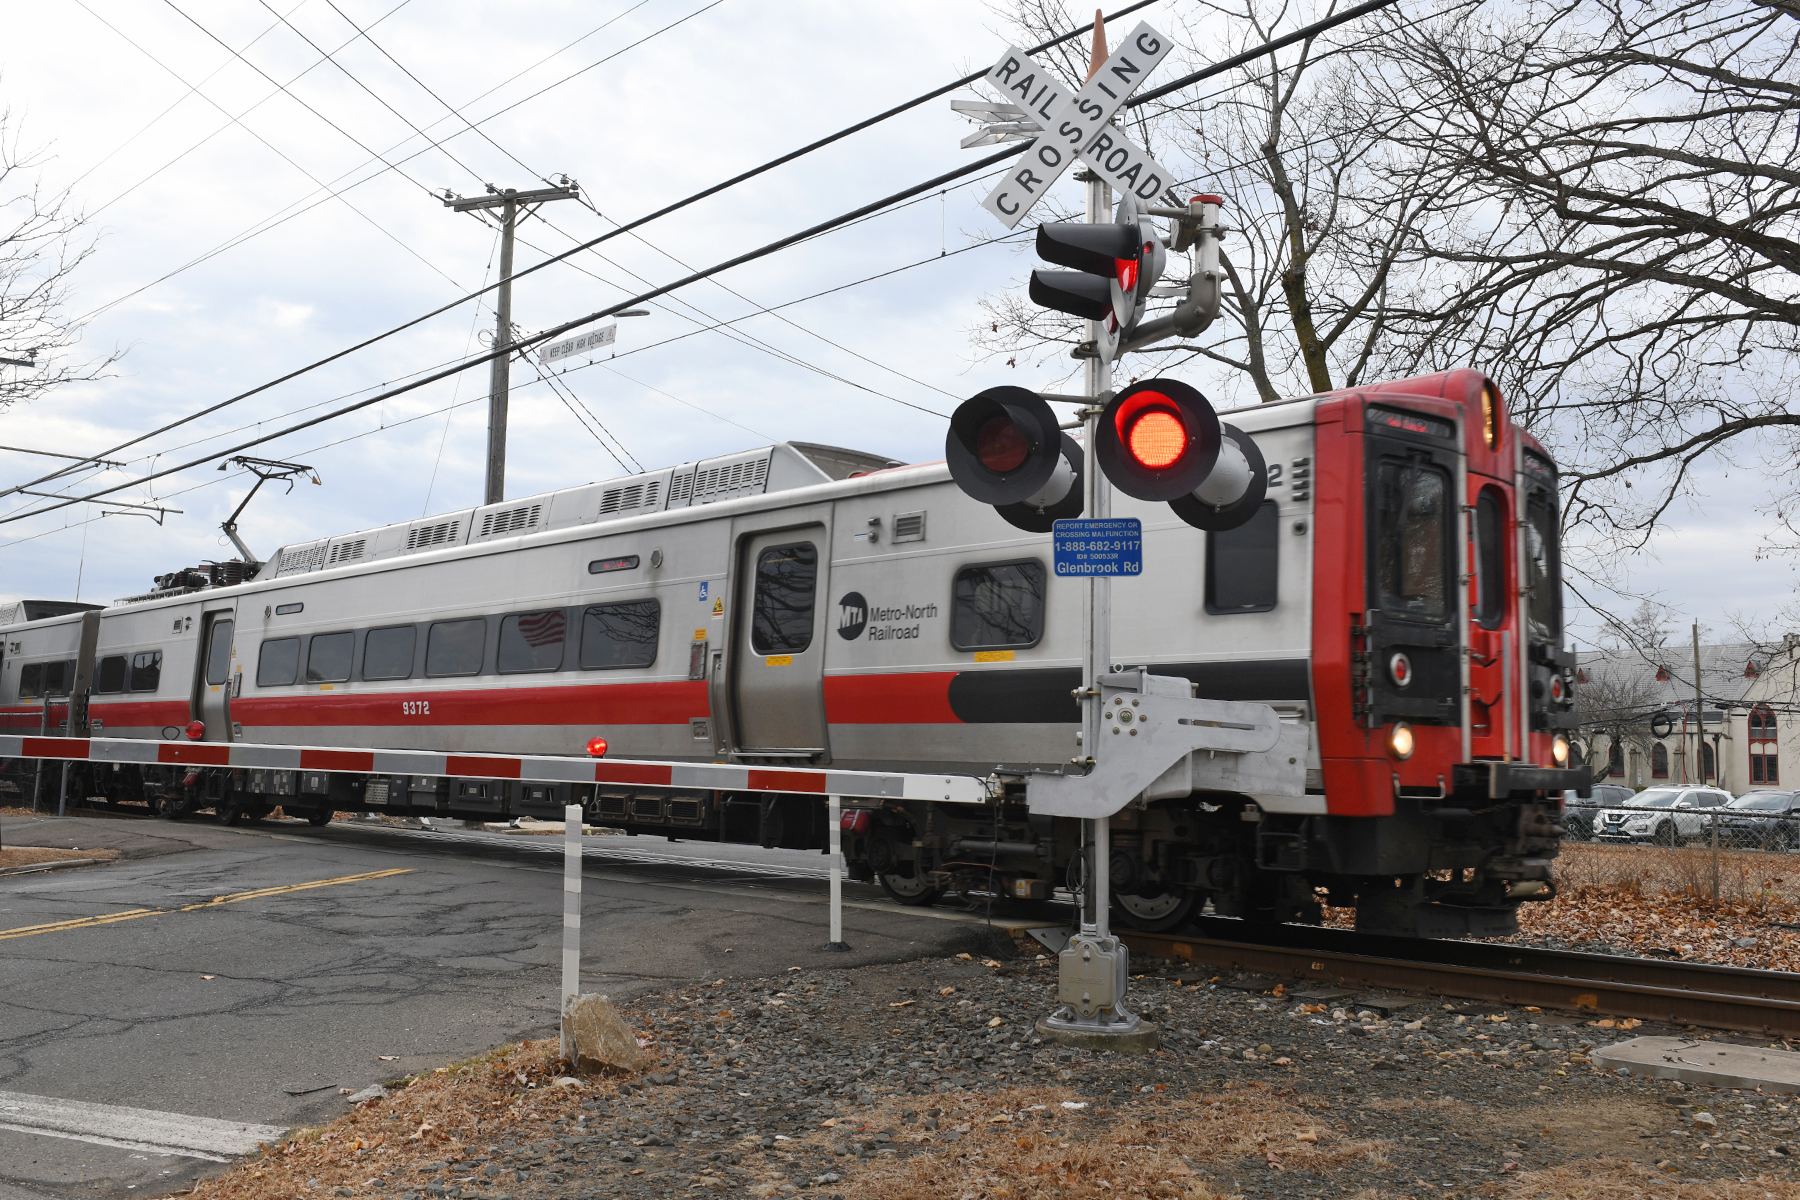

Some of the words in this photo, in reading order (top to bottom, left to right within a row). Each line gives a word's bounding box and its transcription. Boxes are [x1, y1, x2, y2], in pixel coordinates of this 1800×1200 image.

[995, 56, 1058, 121] RAIL
[1087, 132, 1162, 200] ROAD
[996, 32, 1161, 216] CROSSING
[1055, 541, 1140, 551] 1-888-682-9117
[1057, 562, 1119, 573] Glenbrook
[1123, 562, 1139, 572] Rd
[869, 603, 938, 622] Metro-North
[868, 624, 920, 641] Railroad
[402, 701, 430, 715] 9372
